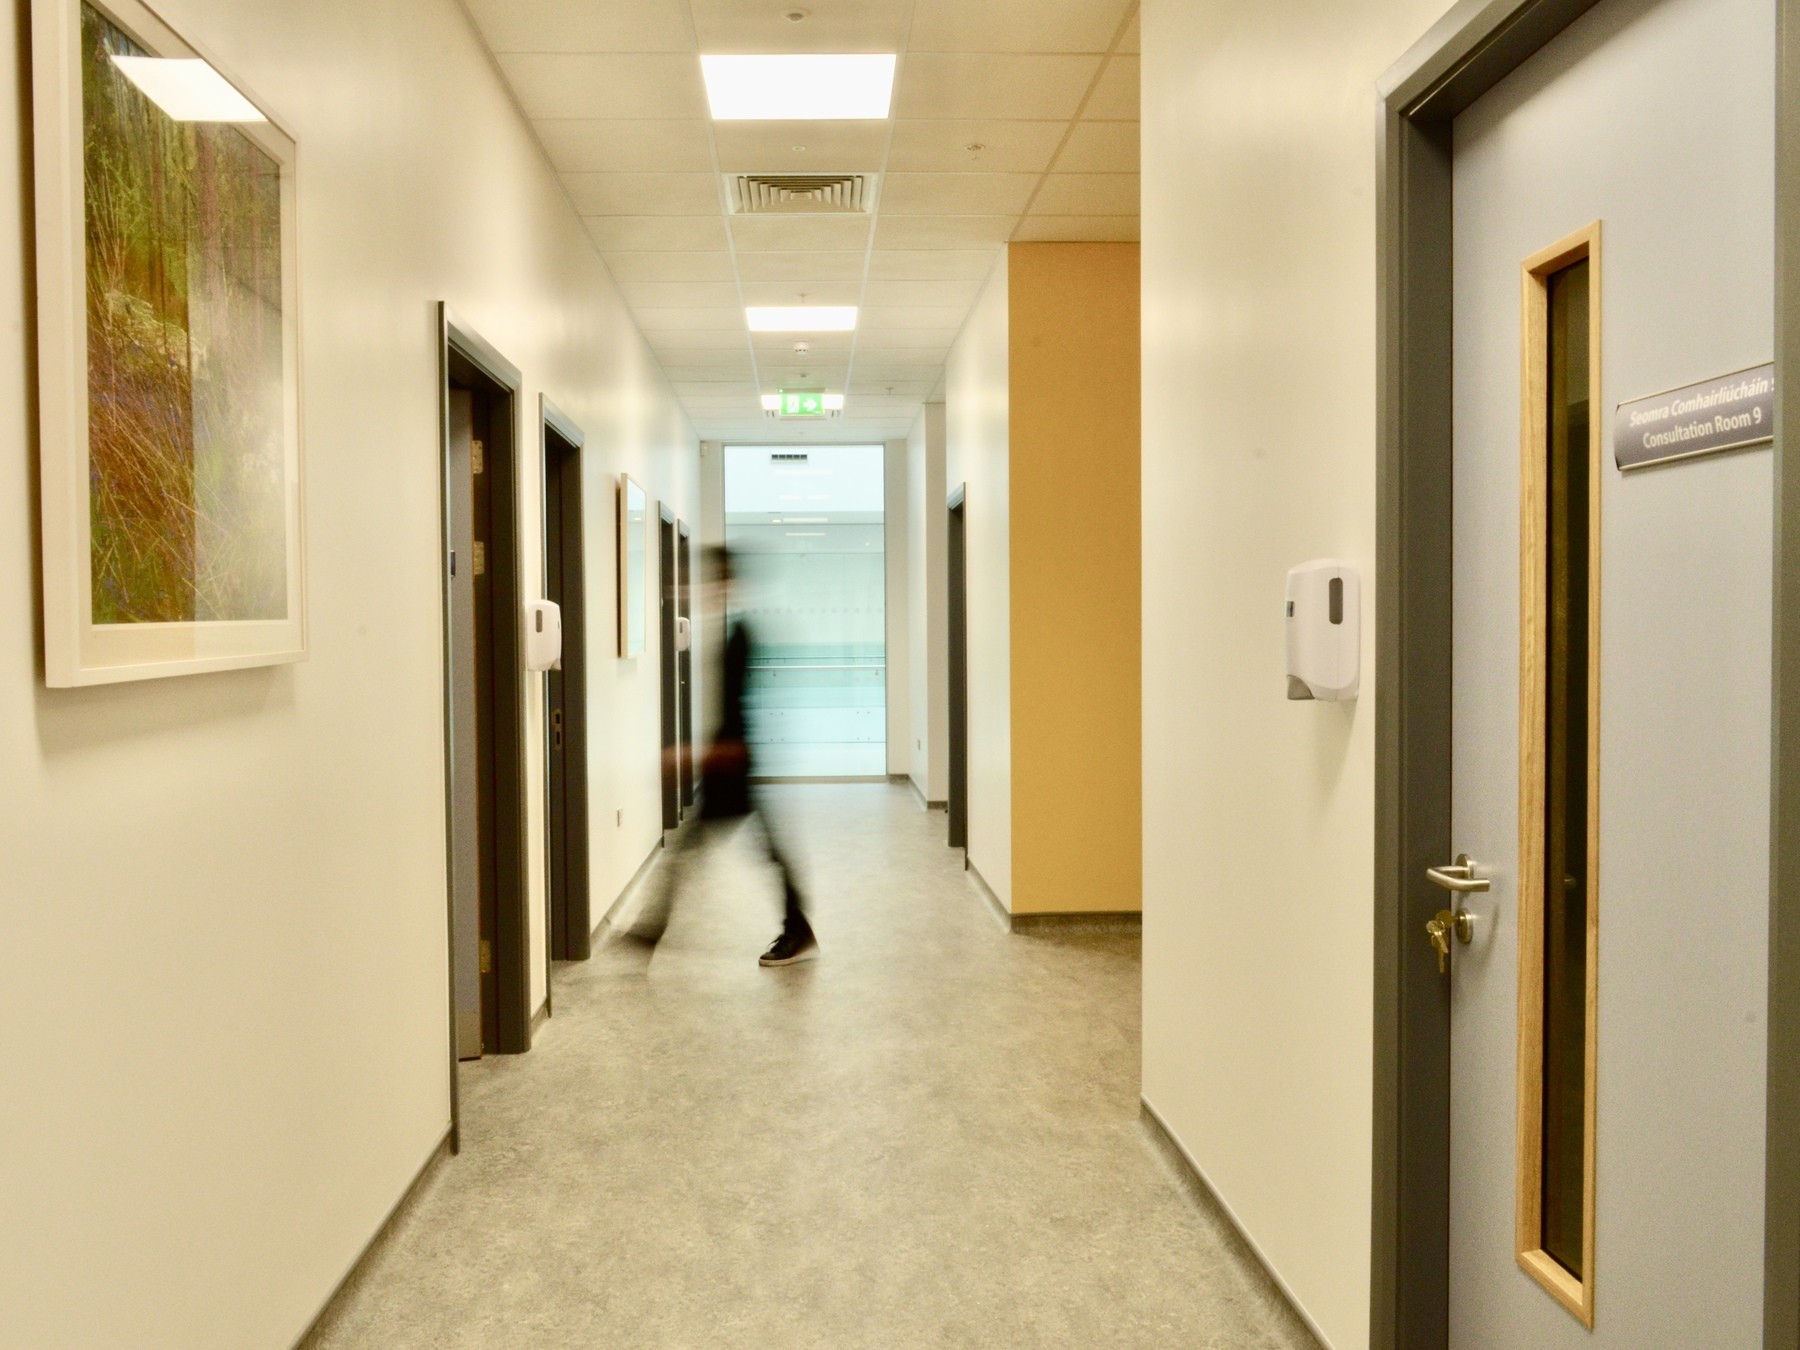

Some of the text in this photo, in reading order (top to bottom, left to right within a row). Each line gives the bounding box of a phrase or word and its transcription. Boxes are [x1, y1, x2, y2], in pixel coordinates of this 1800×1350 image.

[1629, 406, 1669, 427] Seomra
[1671, 377, 1769, 416] Comhairliúcháin
[1643, 406, 1762, 449] Consultation Room 9
